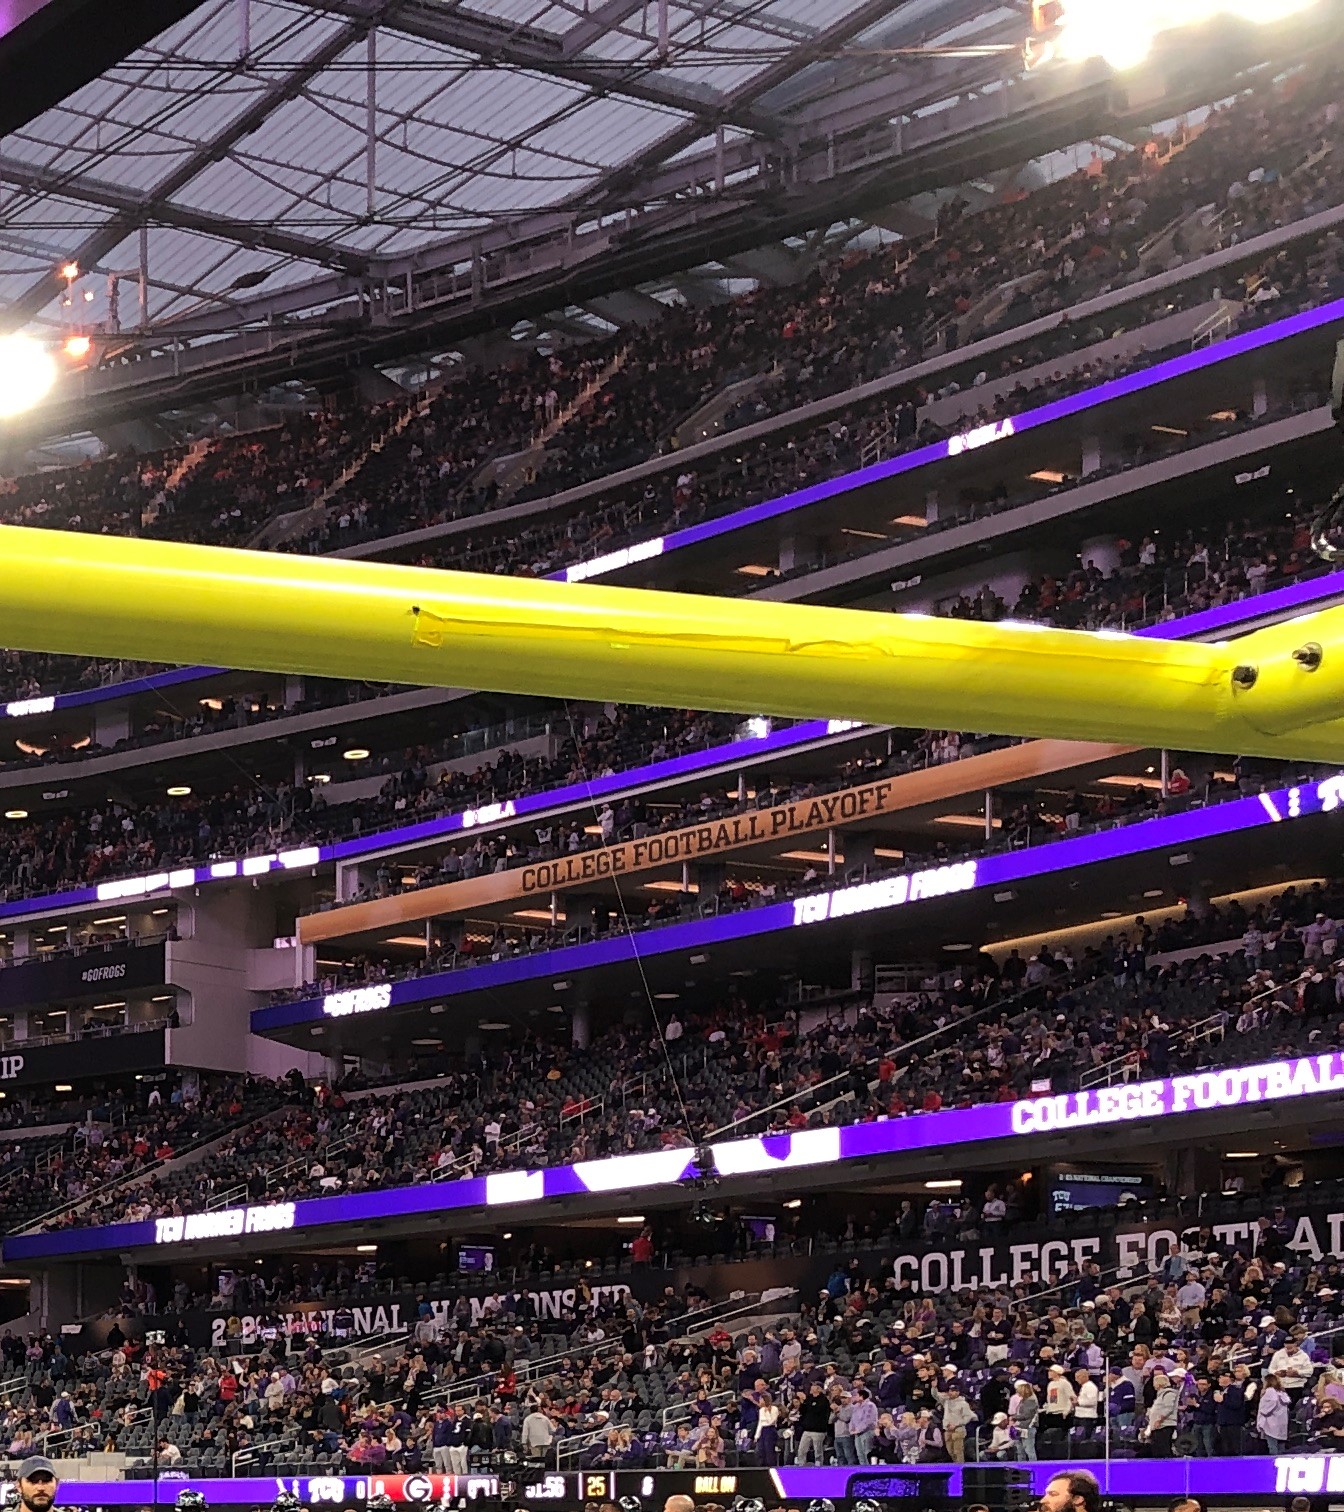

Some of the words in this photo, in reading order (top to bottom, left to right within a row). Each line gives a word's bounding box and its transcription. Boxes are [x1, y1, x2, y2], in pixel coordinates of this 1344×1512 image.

[522, 850, 625, 891] COLLEGE
[633, 817, 765, 865] FOOTBALL
[771, 784, 892, 835] PLAYOFF
[81, 963, 126, 982] #GOFROGS
[1011, 1076, 1164, 1134] COLLEGE
[1172, 1051, 1344, 1115] FOOTBAL
[894, 1237, 1100, 1294] COLLEGE
[355, 1480, 366, 1500] 0
[587, 1476, 605, 1496] 25
